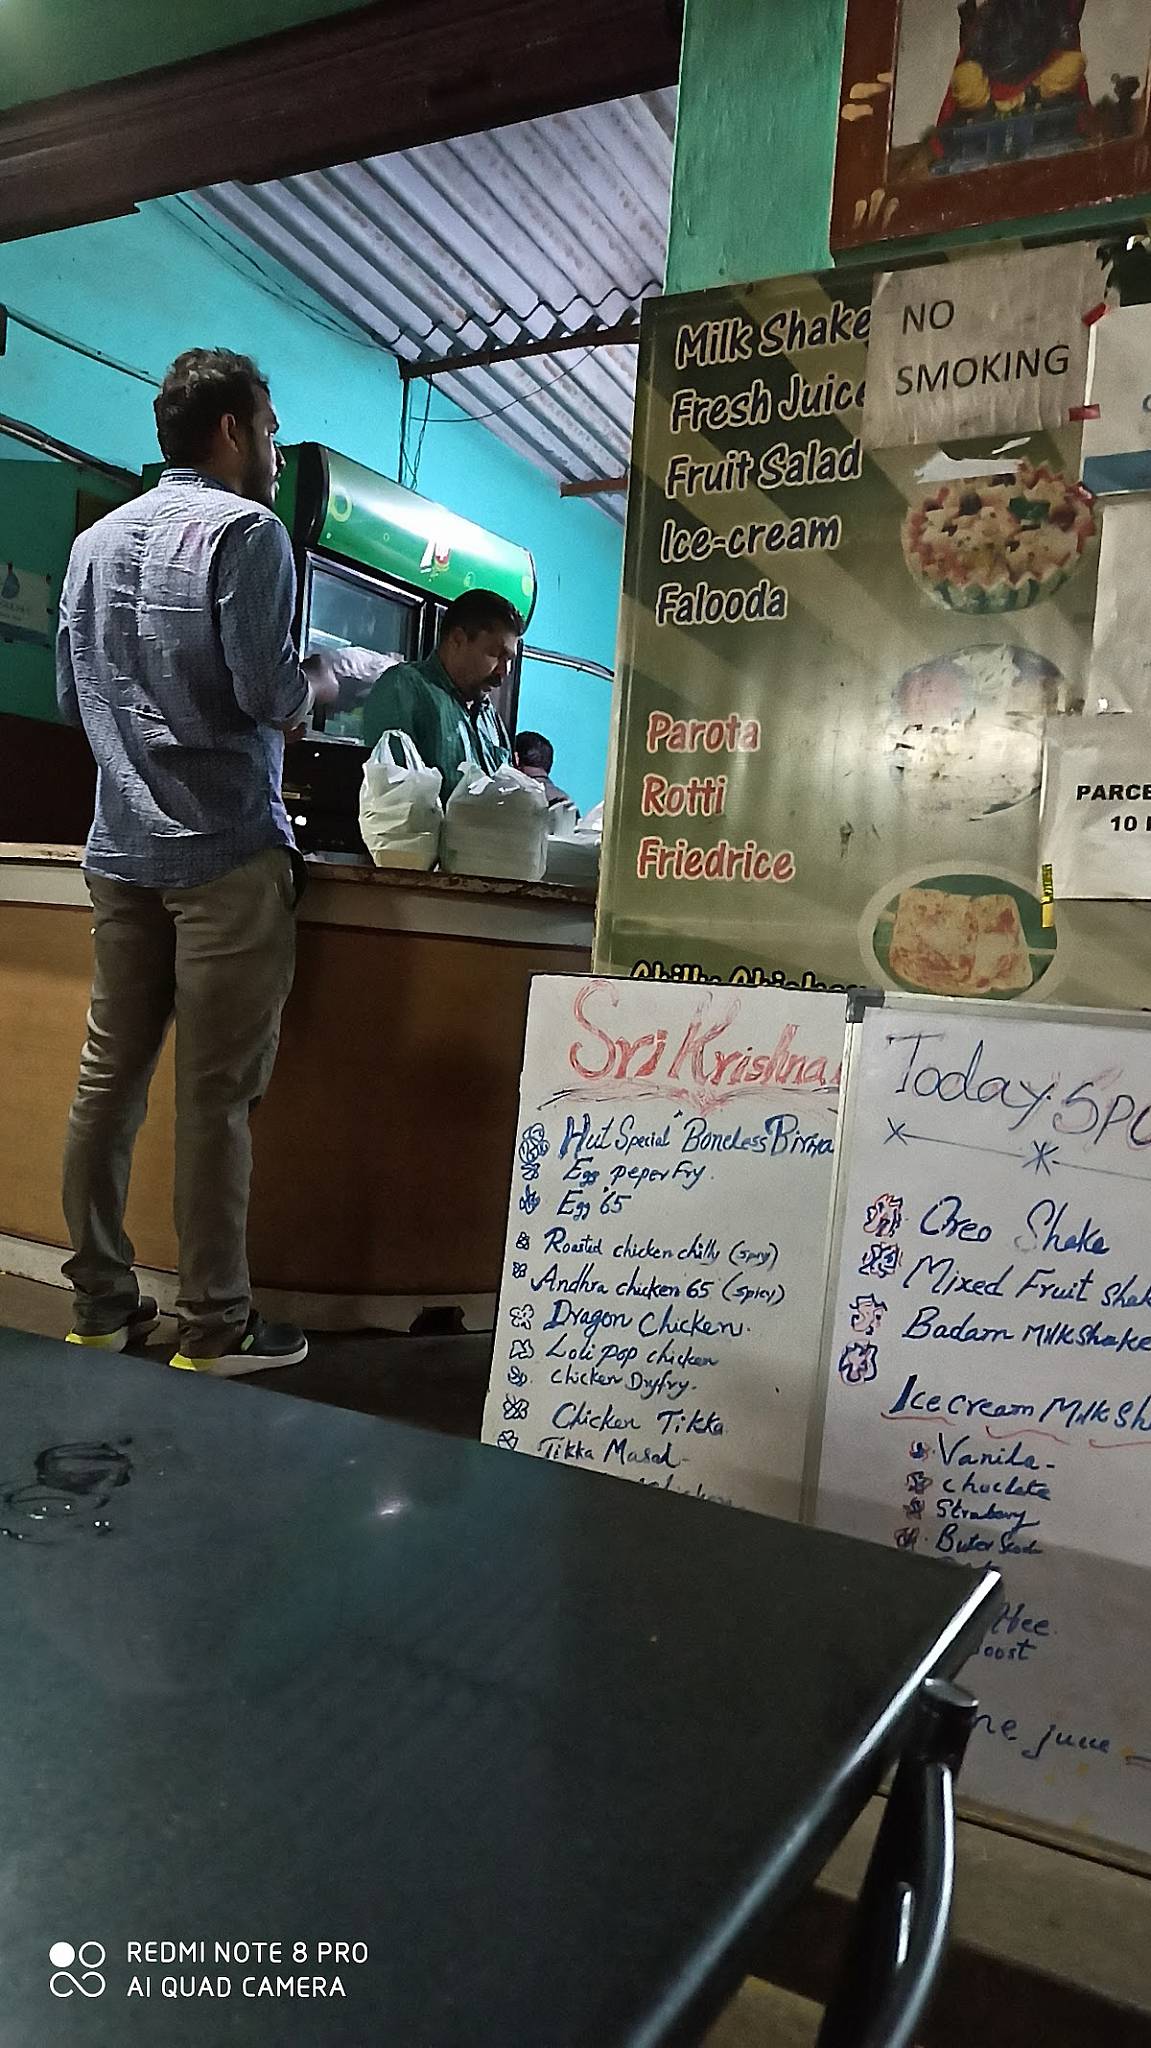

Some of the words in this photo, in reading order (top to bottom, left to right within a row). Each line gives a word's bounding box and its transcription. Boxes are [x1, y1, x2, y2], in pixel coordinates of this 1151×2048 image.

[676, 317, 753, 369] Milk
[759, 303, 871, 357] Shake
[902, 300, 955, 335] NO
[896, 344, 1069, 397] SMOKING
[670, 380, 771, 433] Fresh
[665, 455, 753, 500] Fruit
[758, 438, 863, 490] Salad
[660, 514, 840, 564] Ice-cream
[656, 580, 788, 626] Falooda
[647, 710, 760, 754] Parota
[641, 773, 727, 817] Rotti
[1077, 784, 1151, 800] PARC
[1111, 815, 1138, 831] 10
[636, 836, 795, 882] Friedrice
[570, 980, 668, 1080] Sri
[668, 1000, 828, 1086] Krishna
[559, 1113, 614, 1159] Hut
[615, 1114, 671, 1156] Special
[563, 1156, 600, 1187] Egg
[556, 1189, 591, 1220] Egg
[920, 1196, 992, 1242] Oreo
[1014, 1199, 1110, 1254] Shake
[544, 1227, 603, 1254] Roasted
[613, 1234, 672, 1259] chicken
[531, 1263, 608, 1294] Andhra
[616, 1265, 681, 1300] chicken
[686, 1279, 715, 1298] 65
[903, 1255, 1014, 1296] Mixed
[1015, 1268, 1094, 1302] Fruit
[543, 1299, 633, 1341] Dragon
[902, 1306, 1015, 1343] Badam
[551, 1401, 641, 1432] Chicken
[657, 1409, 725, 1436] Tikka
[977, 1638, 1037, 1661] oost
